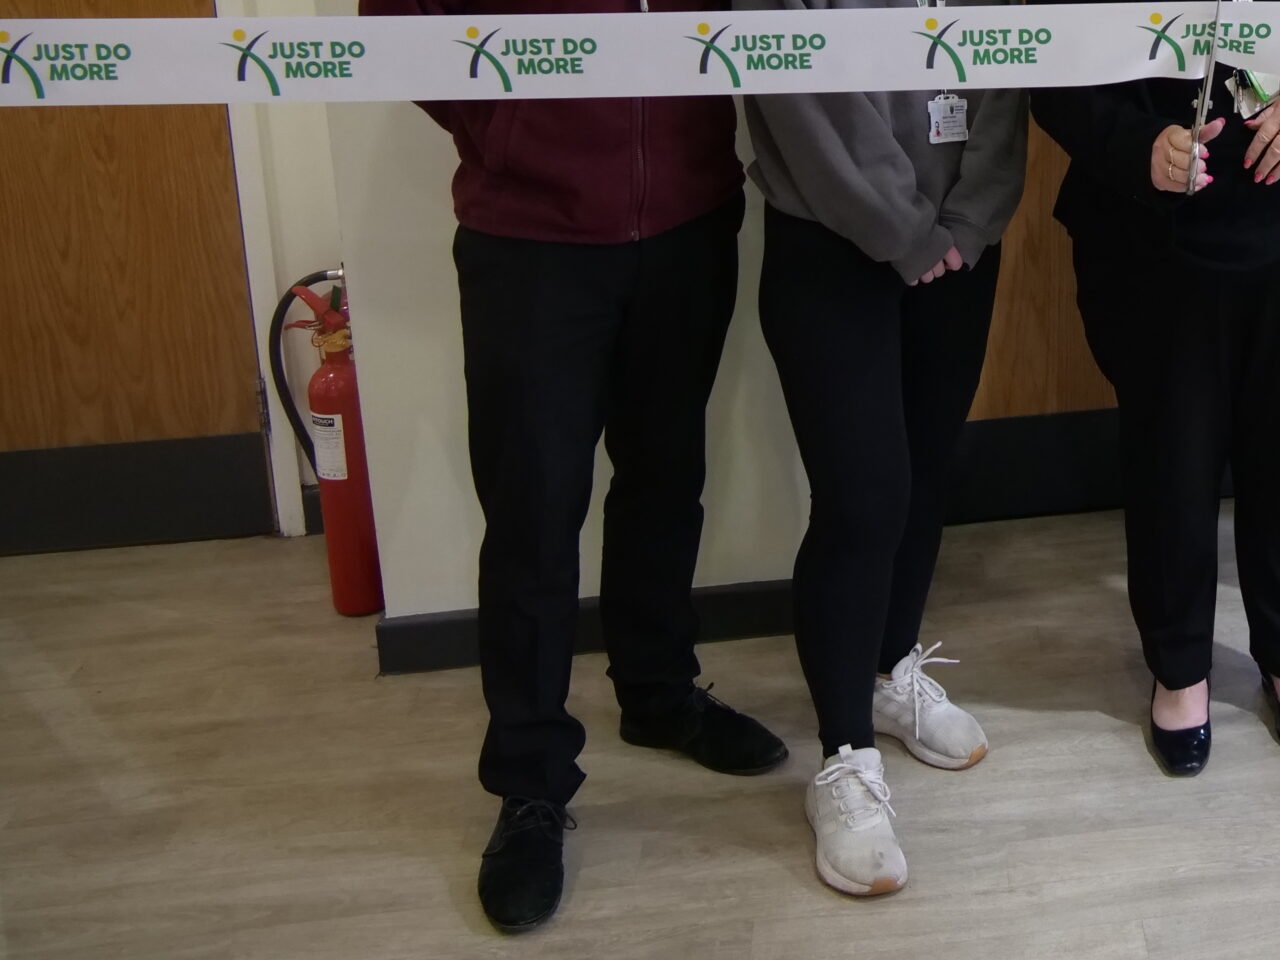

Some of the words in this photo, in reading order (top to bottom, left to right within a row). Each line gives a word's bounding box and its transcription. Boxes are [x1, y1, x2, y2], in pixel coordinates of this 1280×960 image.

[957, 29, 1015, 47] JUST
[1016, 27, 1052, 46] DO
[1181, 21, 1233, 39] JUST
[1239, 23, 1271, 39] DO
[268, 41, 328, 60] JUST
[330, 40, 366, 59] DO
[500, 38, 560, 57] JUST
[562, 37, 597, 56] DO
[731, 34, 789, 52] JUST
[791, 33, 826, 51] DO
[32, 43, 94, 62] JUST
[95, 43, 131, 61] DO
[746, 51, 812, 71] MORE
[972, 46, 1038, 65] MORE
[49, 61, 118, 81] MORE
[284, 60, 353, 79] MORE
[516, 56, 584, 75] MORE
